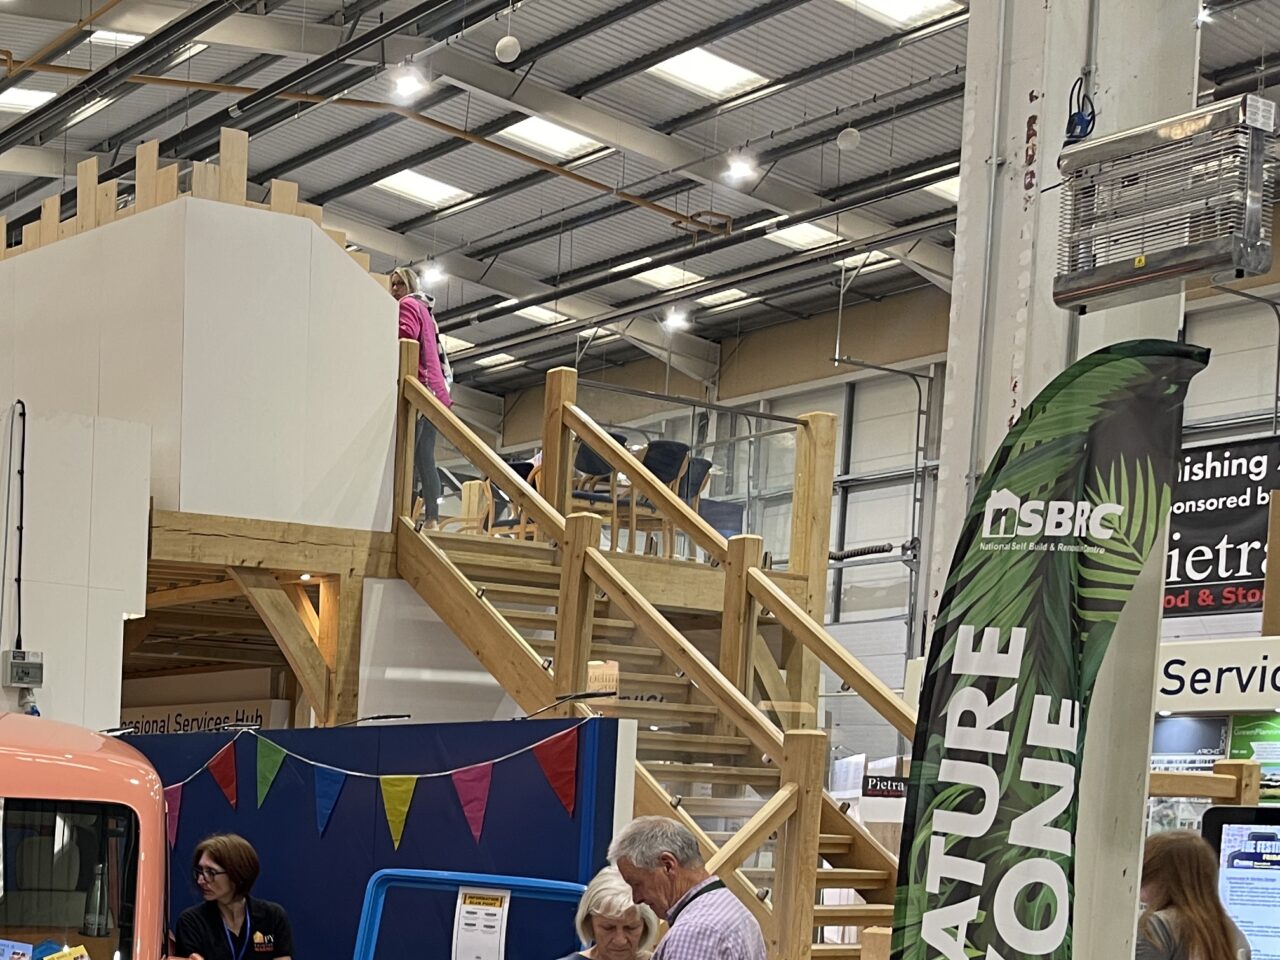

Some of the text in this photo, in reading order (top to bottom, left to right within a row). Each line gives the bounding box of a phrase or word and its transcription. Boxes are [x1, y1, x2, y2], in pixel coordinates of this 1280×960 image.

[1178, 451, 1268, 482] ishing
[1169, 485, 1271, 514] onsored b
[980, 542, 1010, 551] National
[1011, 542, 1027, 551] Self
[1028, 543, 1048, 551] Build
[1049, 543, 1055, 551] &
[1197, 588, 1214, 606] &
[1222, 586, 1265, 604] Sto
[173, 711, 230, 732] Services
[868, 777, 905, 791] Pietra
